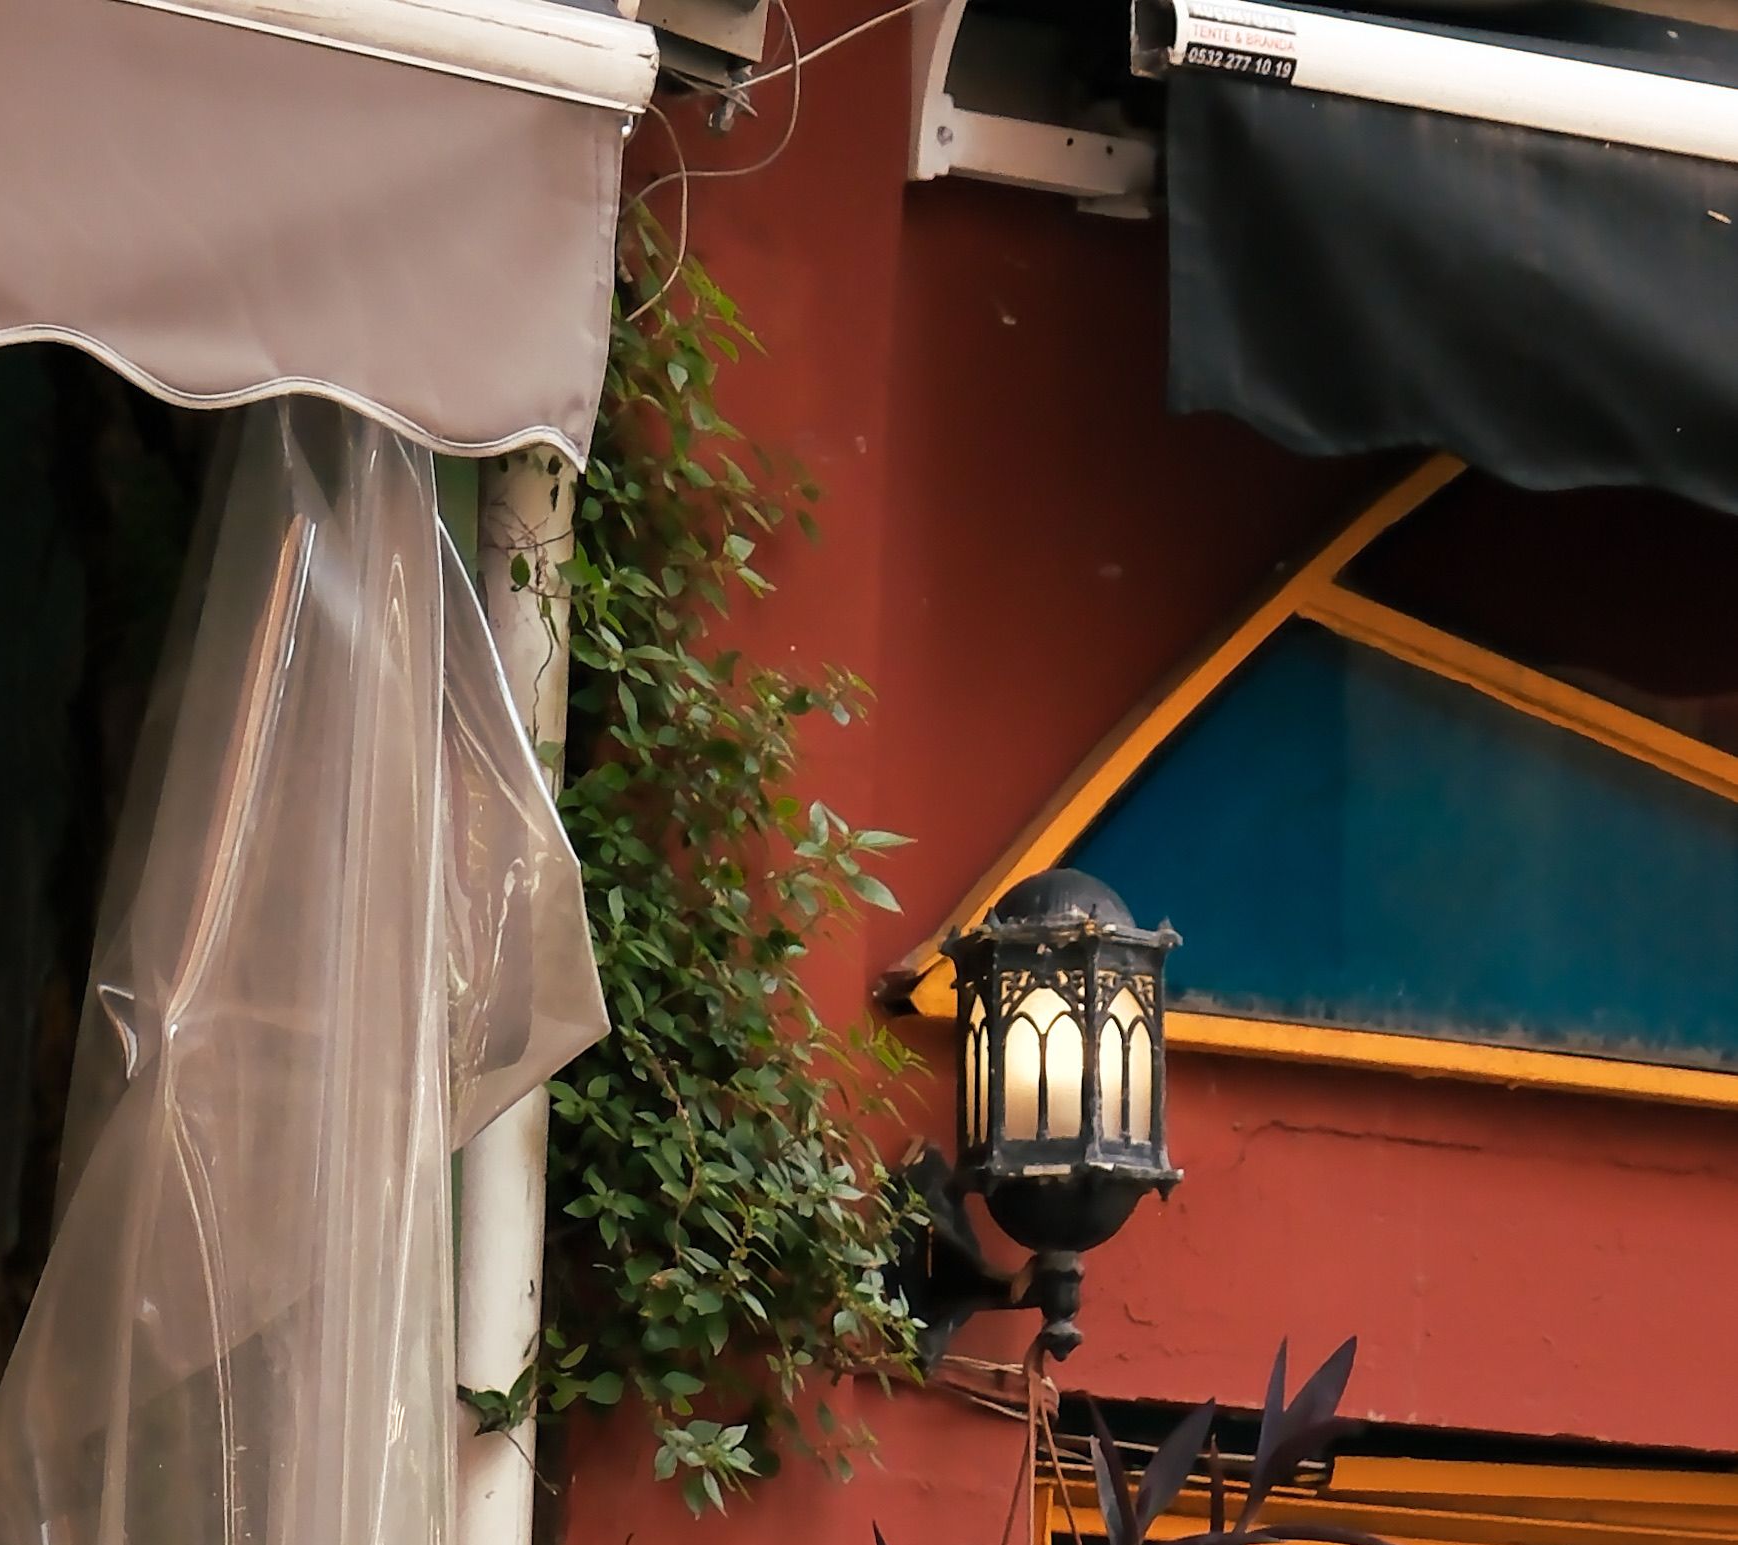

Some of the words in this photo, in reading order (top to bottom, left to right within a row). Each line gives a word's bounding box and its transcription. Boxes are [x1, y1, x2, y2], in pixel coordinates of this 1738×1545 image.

[1192, 23, 1231, 42] TENTE
[1188, 47, 1224, 67] 0532
[1224, 52, 1252, 72] 277
[1255, 58, 1272, 76] 10
[1275, 61, 1292, 79] 19
